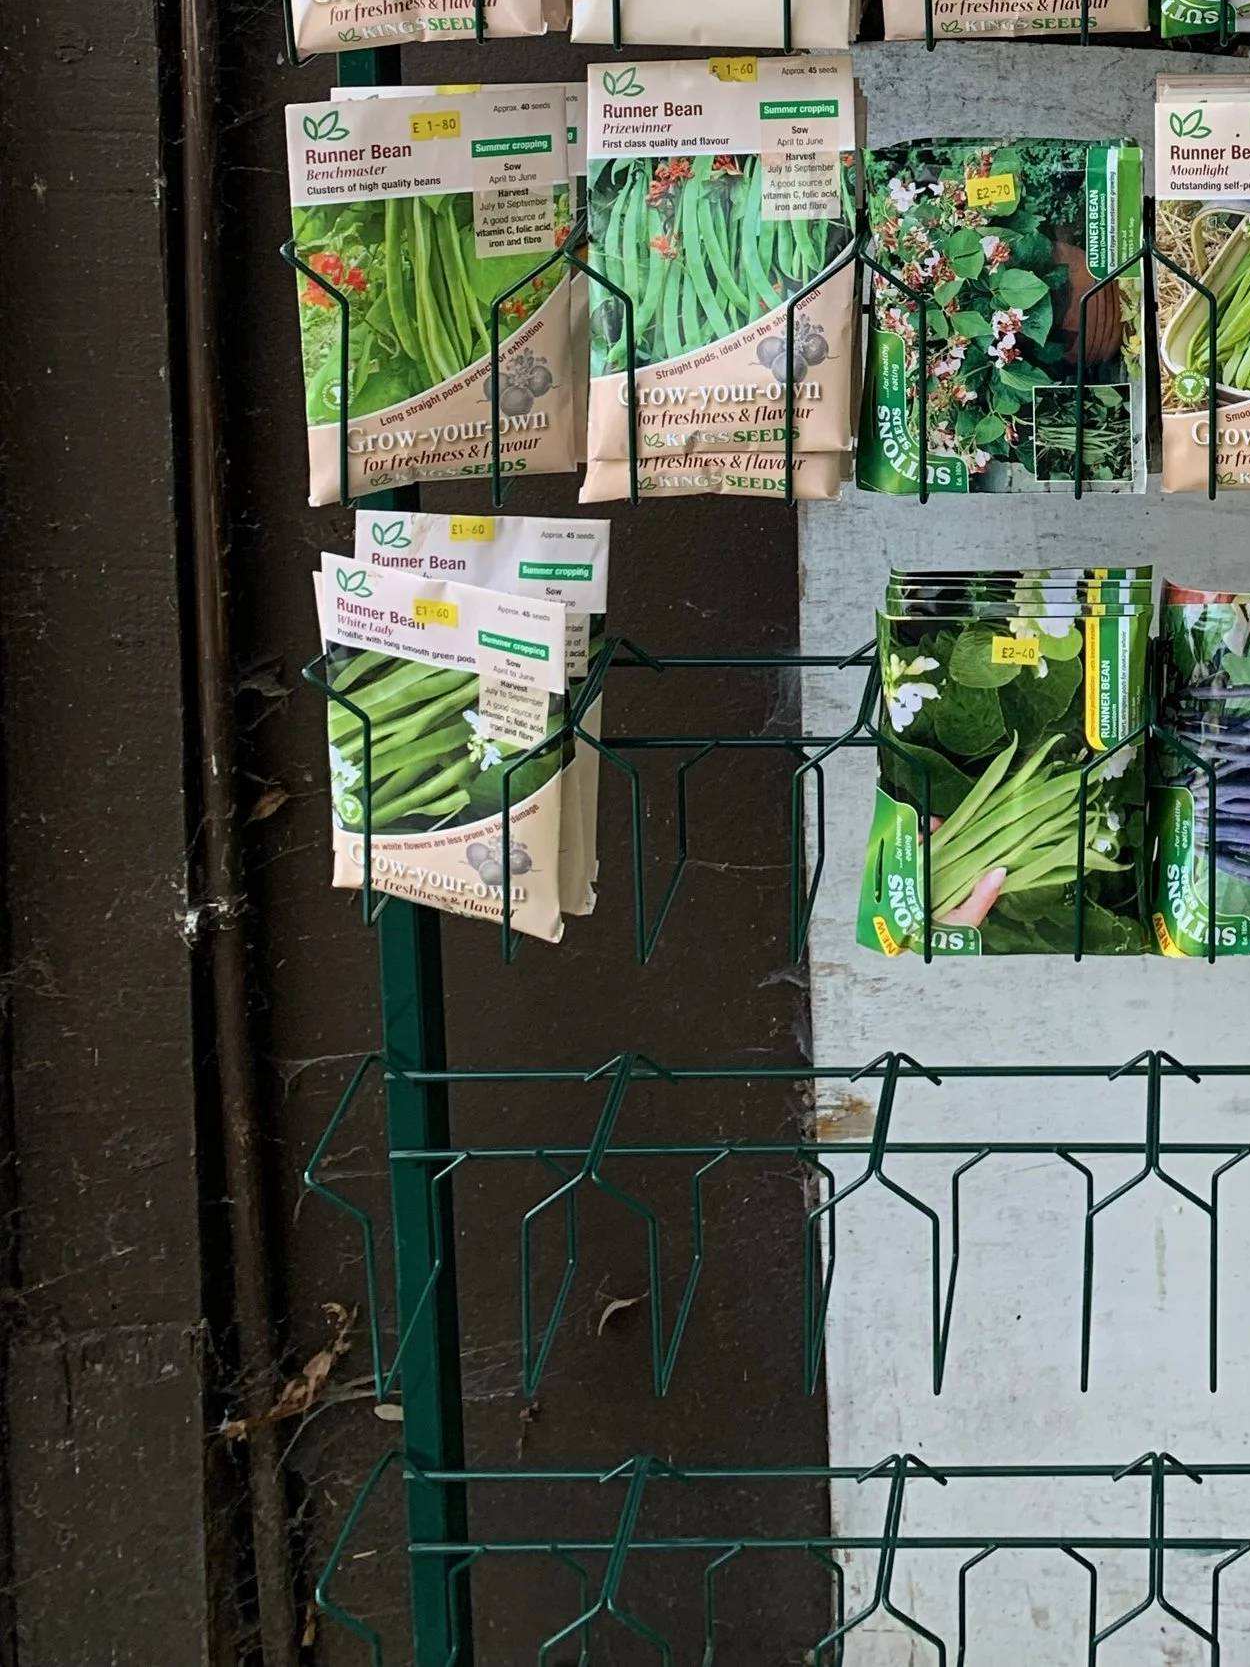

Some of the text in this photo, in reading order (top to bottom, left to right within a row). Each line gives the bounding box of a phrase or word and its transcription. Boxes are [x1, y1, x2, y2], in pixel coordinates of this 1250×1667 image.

[726, 63, 754, 75] 1-60
[603, 102, 702, 118] Runner Bean
[603, 122, 673, 134] Prizewinner
[306, 164, 388, 181] Benchmaster
[1170, 164, 1230, 177] Moonlight
[976, 185, 1010, 199] £2-70
[1089, 189, 1099, 268] RUNNER BEAN
[337, 614, 394, 637] White Lady
[1001, 647, 1035, 660] £2-40
